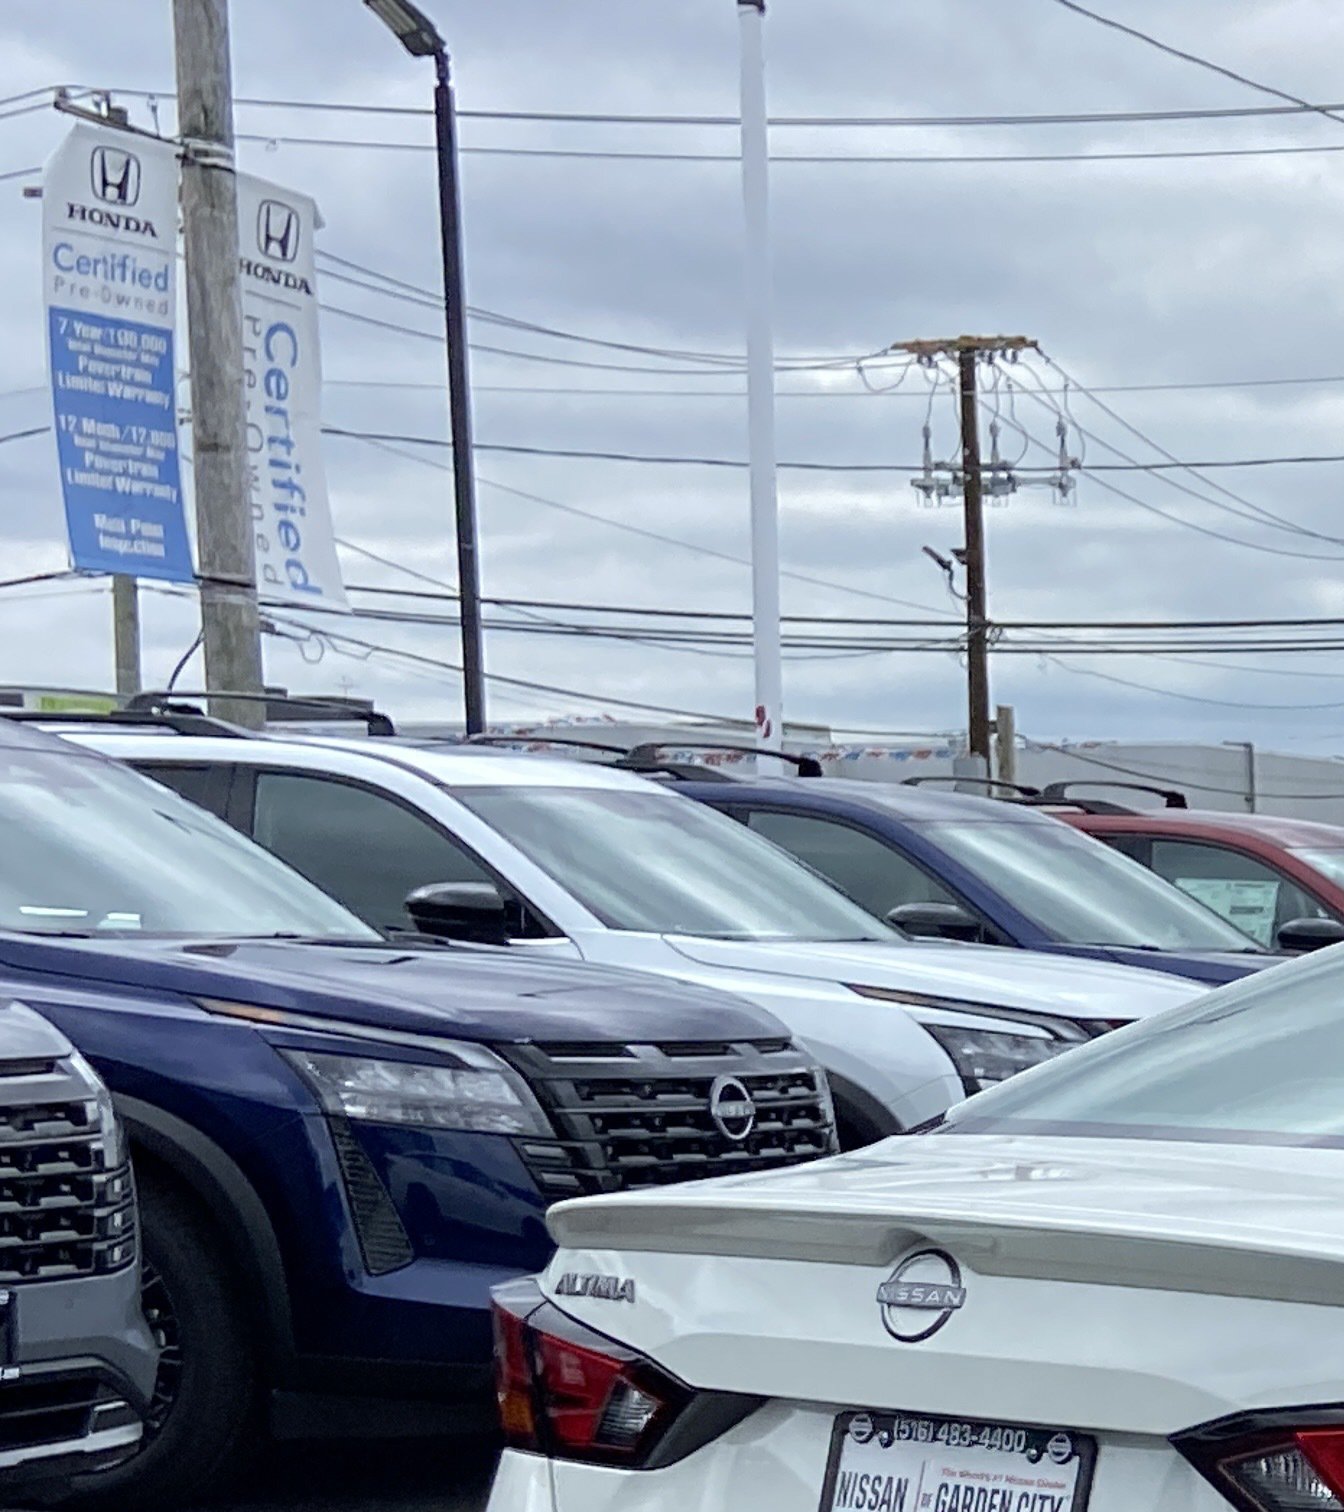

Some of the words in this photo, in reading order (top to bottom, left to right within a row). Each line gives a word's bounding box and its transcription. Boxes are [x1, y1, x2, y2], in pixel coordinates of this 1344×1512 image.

[67, 203, 158, 238] HONDA
[53, 243, 168, 292] Certified
[239, 258, 314, 295] HONDA
[54, 275, 168, 315] Pre-Owned
[59, 317, 68, 335] 7
[264, 321, 323, 595] Certified
[555, 1273, 634, 1303] ALTIMA
[894, 1418, 934, 1441] (516)
[937, 1423, 1026, 1452] 483-4400
